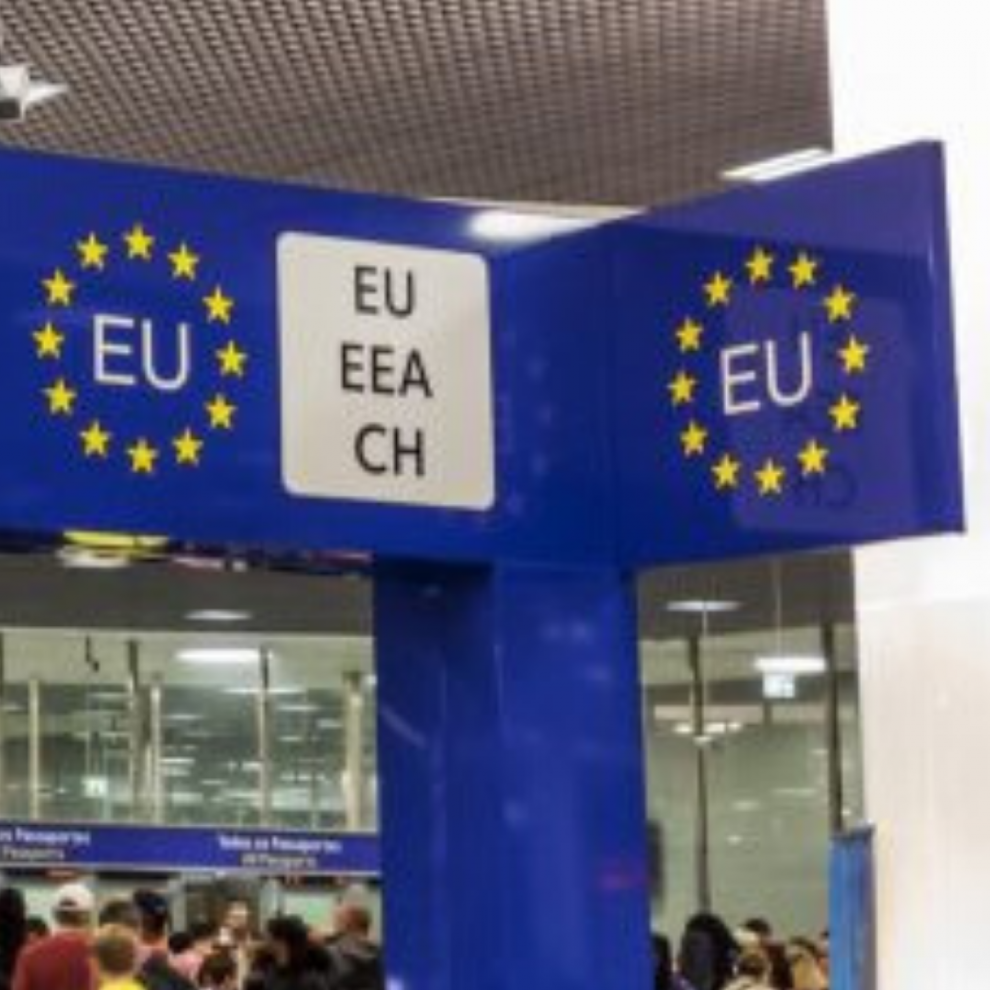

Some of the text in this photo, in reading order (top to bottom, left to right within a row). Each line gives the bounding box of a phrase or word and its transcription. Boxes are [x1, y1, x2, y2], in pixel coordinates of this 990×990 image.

[353, 265, 416, 318] EU
[93, 314, 191, 390] EU
[341, 342, 433, 399] EEA
[720, 331, 813, 415] EU
[353, 423, 426, 477] CH
